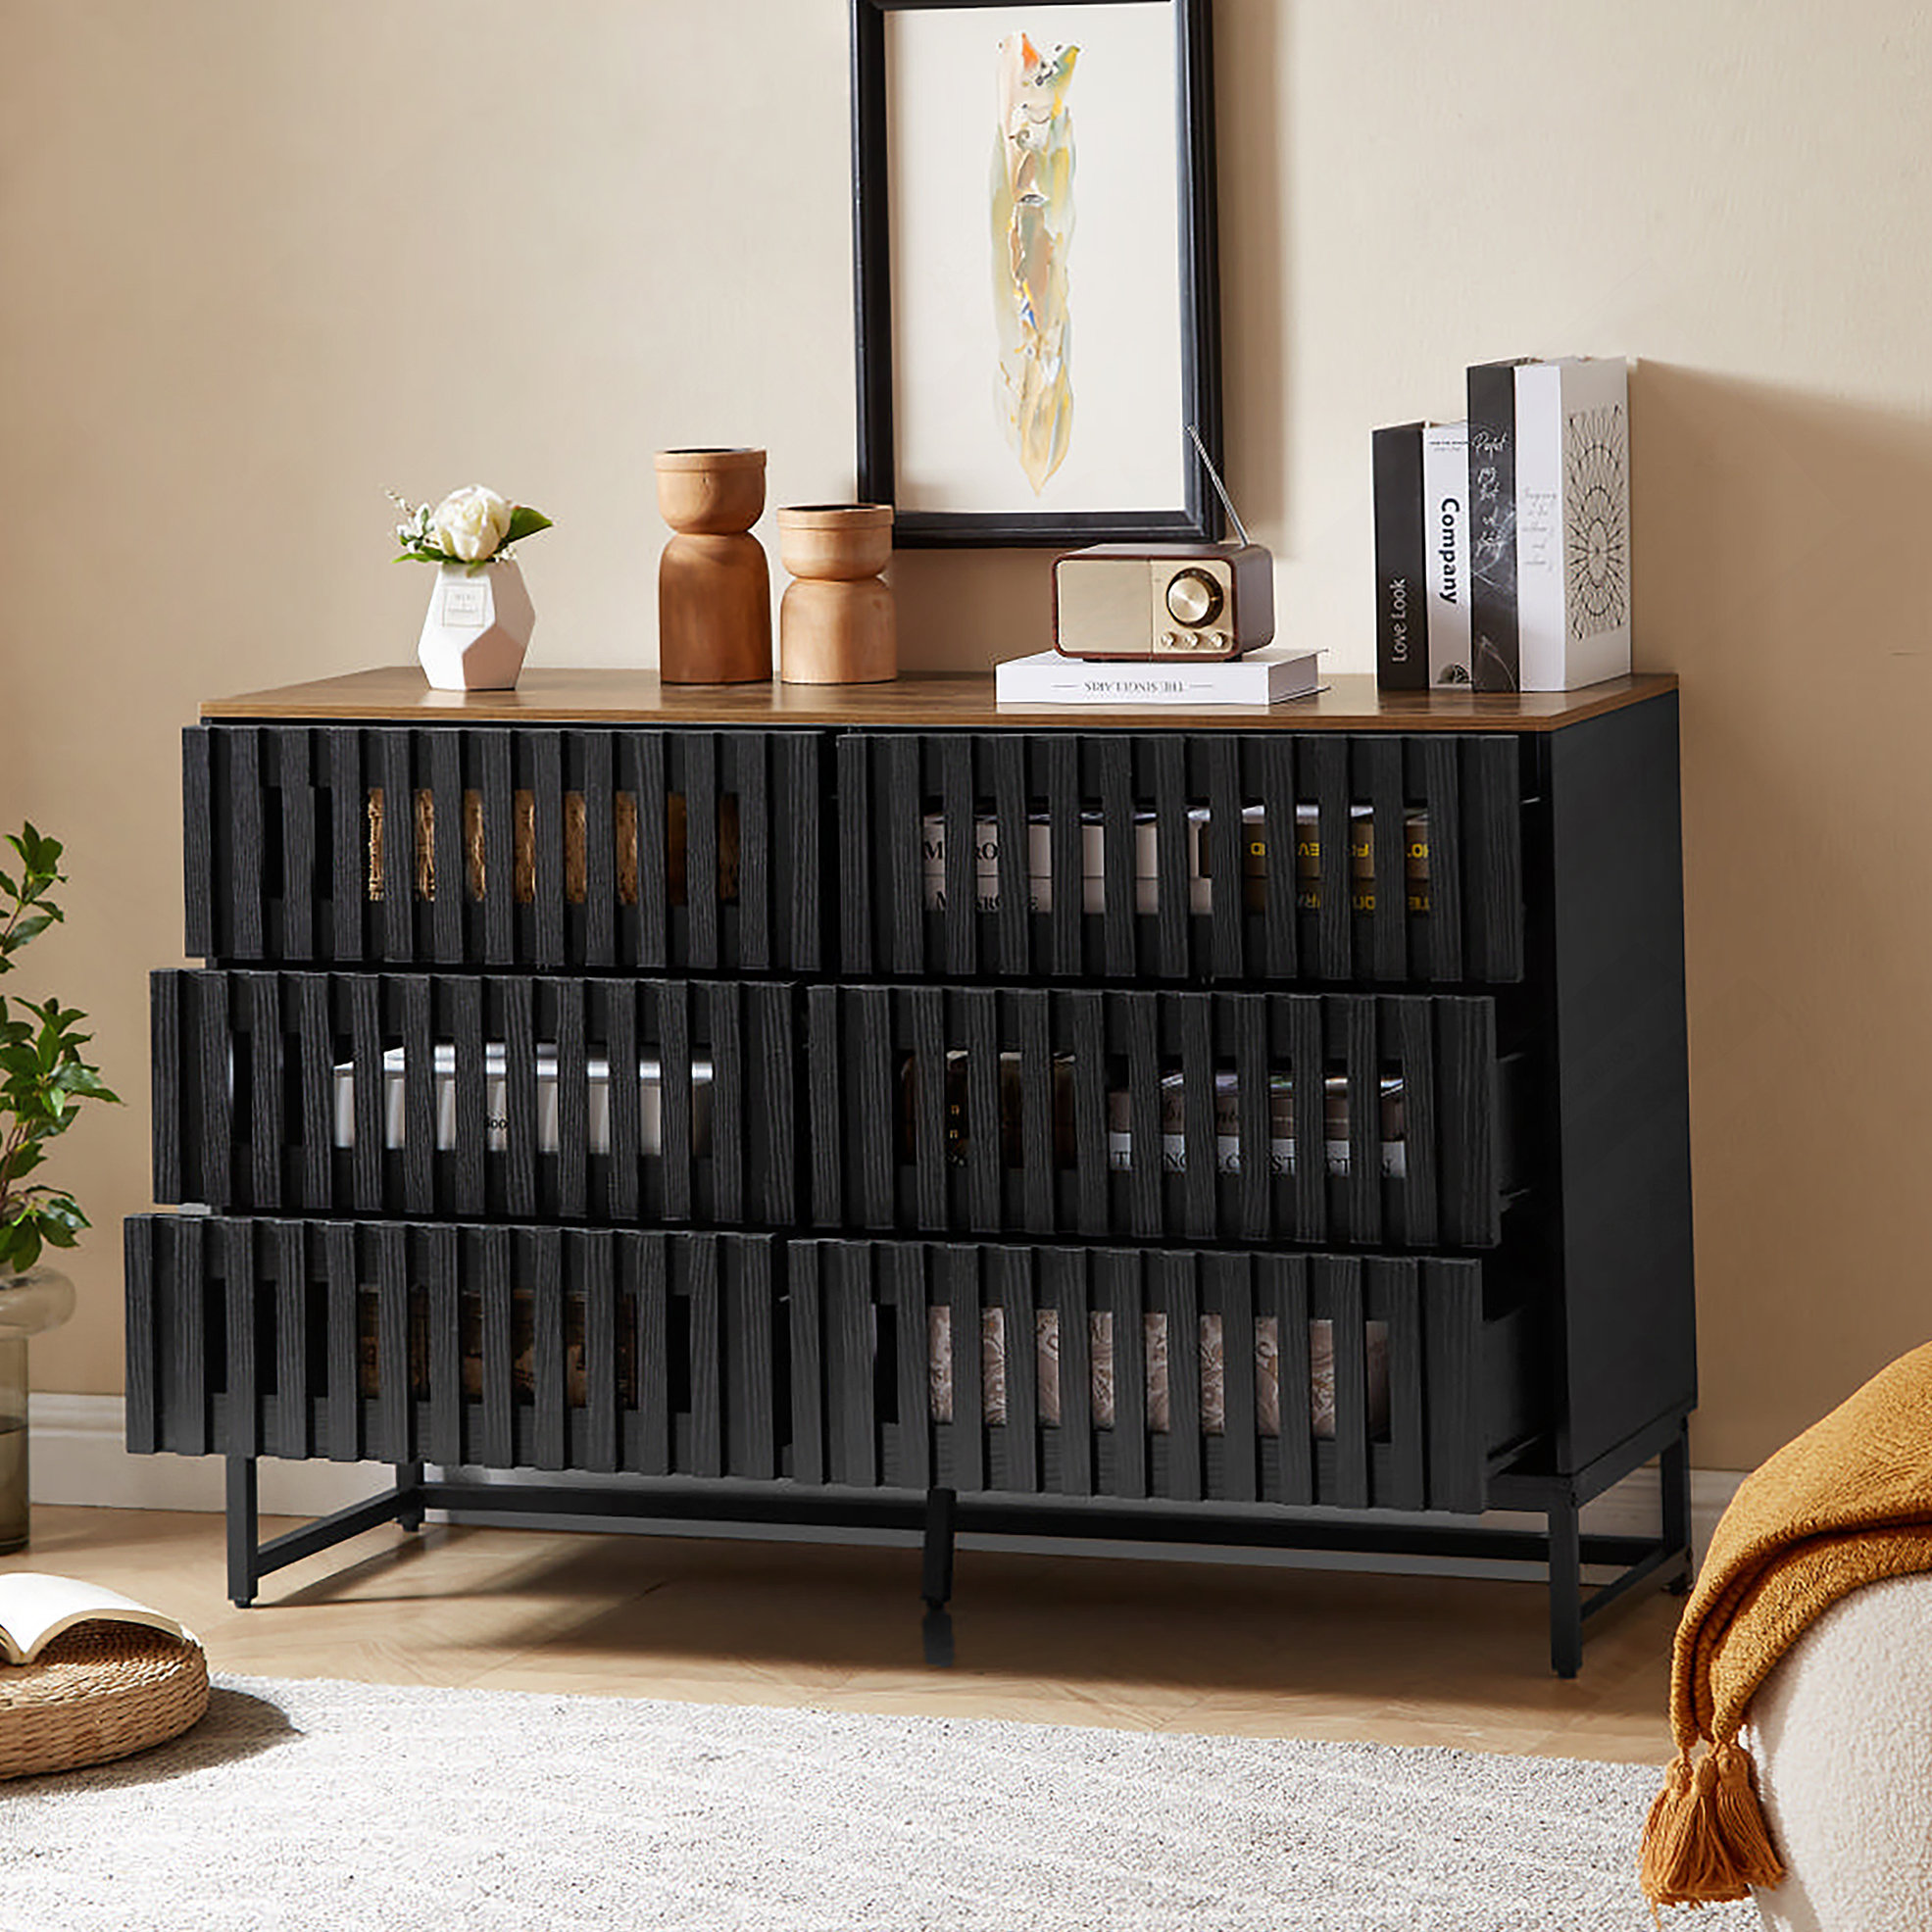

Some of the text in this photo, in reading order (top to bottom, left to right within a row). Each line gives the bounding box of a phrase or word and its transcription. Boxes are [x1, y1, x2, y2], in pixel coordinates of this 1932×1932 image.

[1438, 498, 1461, 605] Company
[1389, 578, 1408, 663] Love Look
